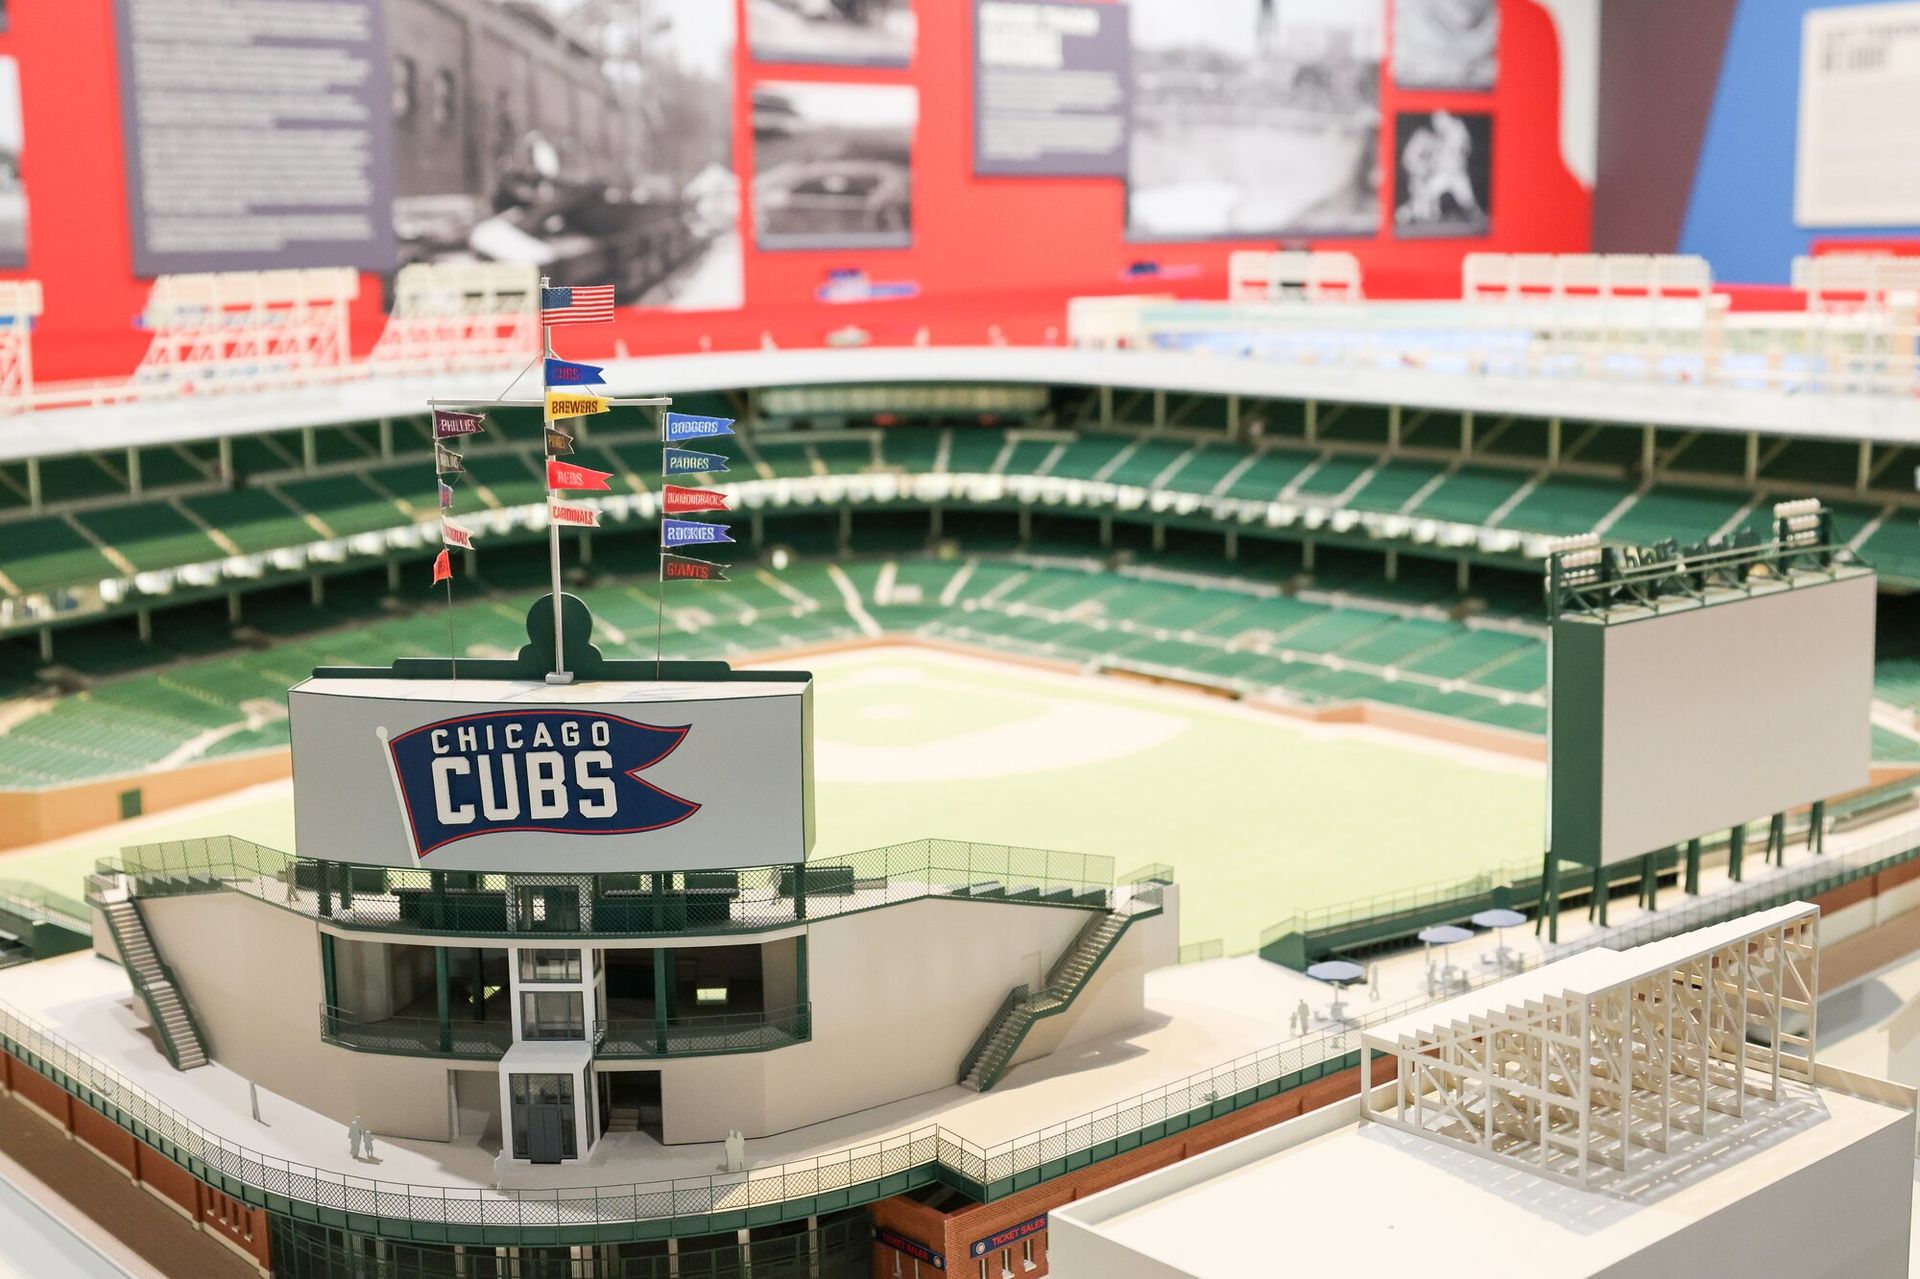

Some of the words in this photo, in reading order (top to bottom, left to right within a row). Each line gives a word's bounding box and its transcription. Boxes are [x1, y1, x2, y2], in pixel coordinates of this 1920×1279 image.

[552, 400, 598, 414] BREWERS
[441, 419, 477, 432] PHILLIES
[671, 421, 718, 434] DODGERS
[670, 457, 709, 470] PADRES
[556, 471, 584, 486] REDS
[552, 505, 593, 525] CARDINALS
[667, 527, 715, 541] ROCKIES
[667, 562, 710, 578] GIANTS
[431, 720, 611, 754] CHICAGO
[431, 750, 618, 825] CUBS
[991, 1229, 1020, 1247] TICKET
[1020, 1218, 1046, 1235] SALES
